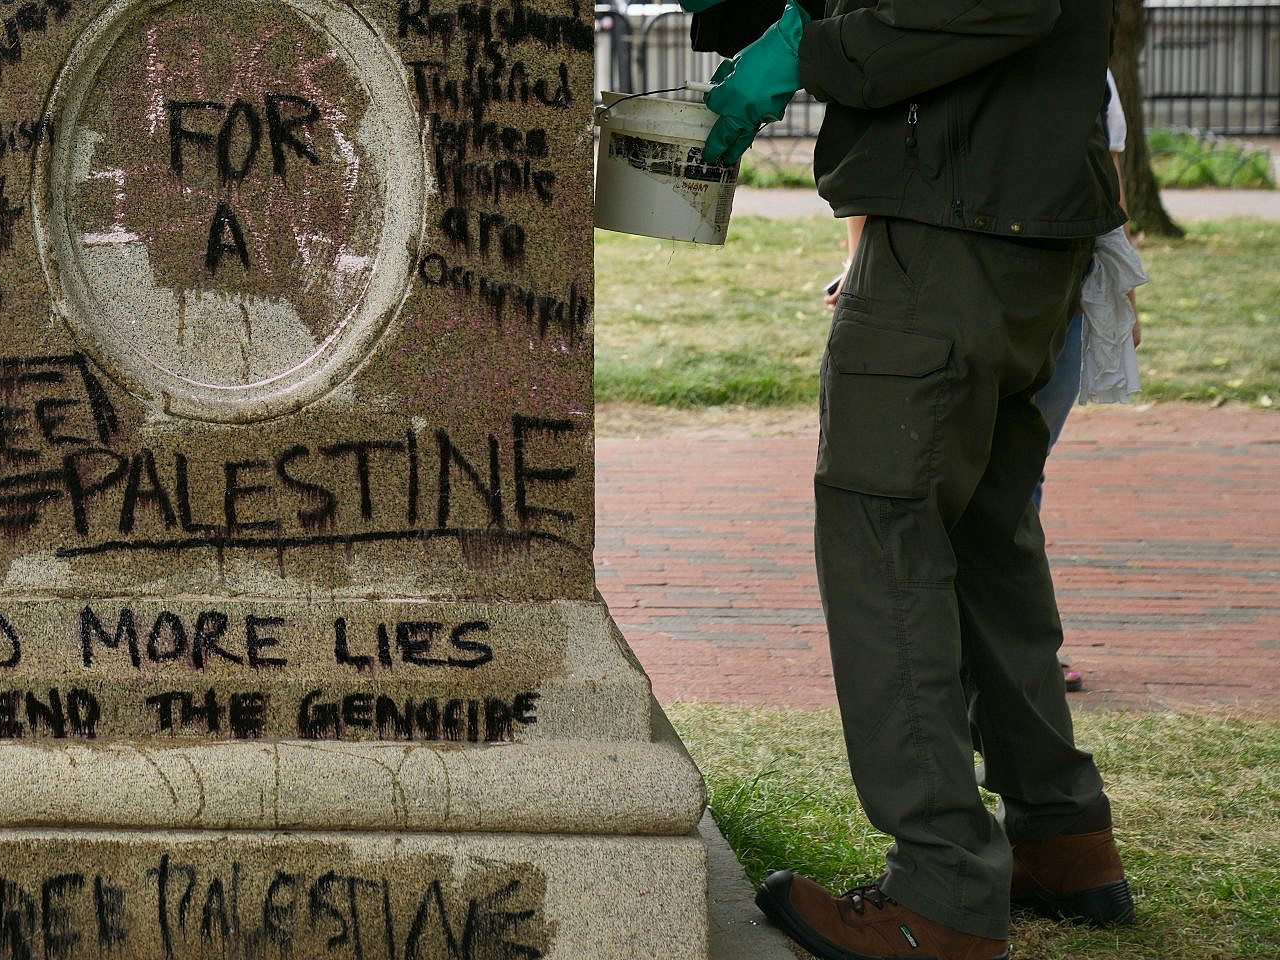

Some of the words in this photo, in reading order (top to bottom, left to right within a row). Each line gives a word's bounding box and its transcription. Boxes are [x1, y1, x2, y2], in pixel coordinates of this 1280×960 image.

[170, 92, 321, 184] FOR
[206, 202, 249, 272] A
[63, 416, 577, 536] PALESTINE
[80, 604, 288, 671] MORE
[333, 616, 494, 671] LIES
[146, 690, 268, 739] THE
[298, 690, 541, 739] GENOCIDE
[146, 853, 544, 960] PALESTINE
